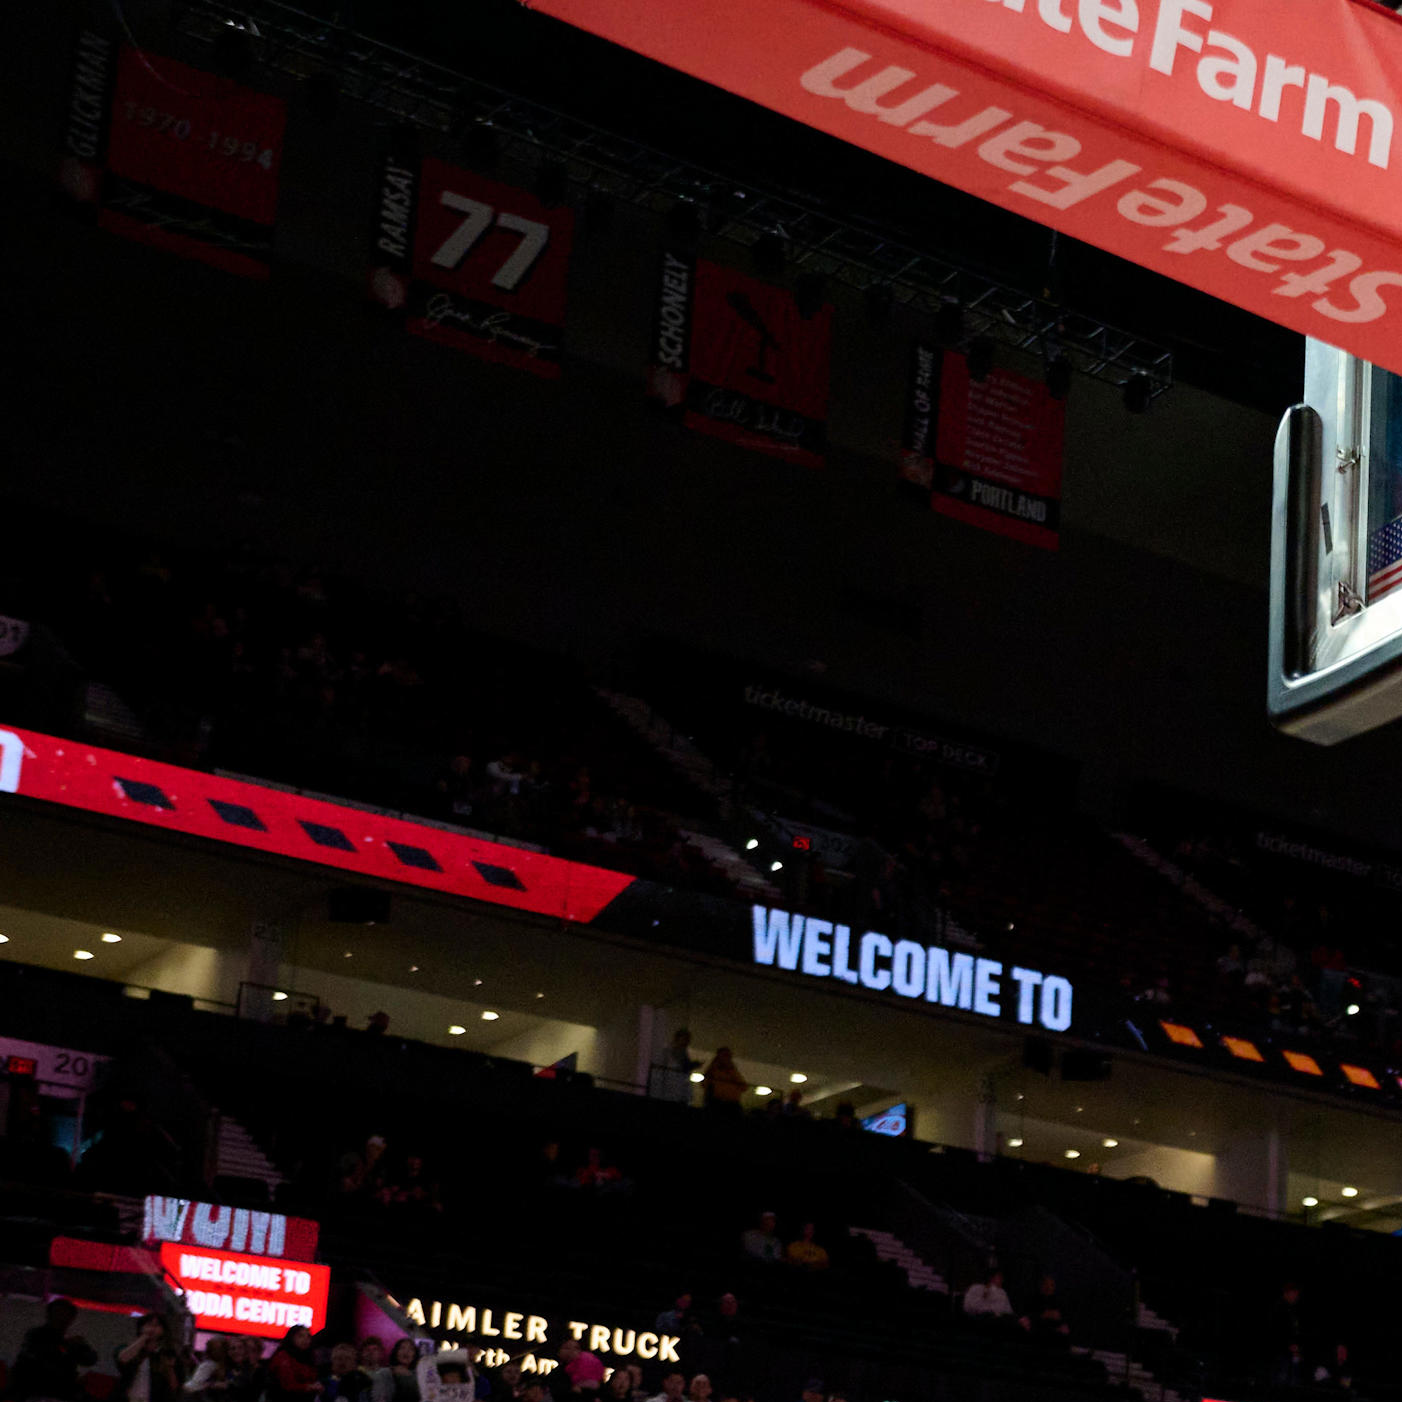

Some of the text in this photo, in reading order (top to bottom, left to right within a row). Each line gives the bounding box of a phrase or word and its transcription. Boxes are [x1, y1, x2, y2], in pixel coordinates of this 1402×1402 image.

[430, 190, 550, 291] 77
[657, 252, 690, 369] SCHONELY
[969, 478, 1047, 522] PORTLAND
[752, 904, 1074, 1033] WELCOME TO
[179, 1253, 312, 1296] WELCOME TO
[234, 1300, 314, 1328] CENTER
[567, 1320, 682, 1363] TRUCK
